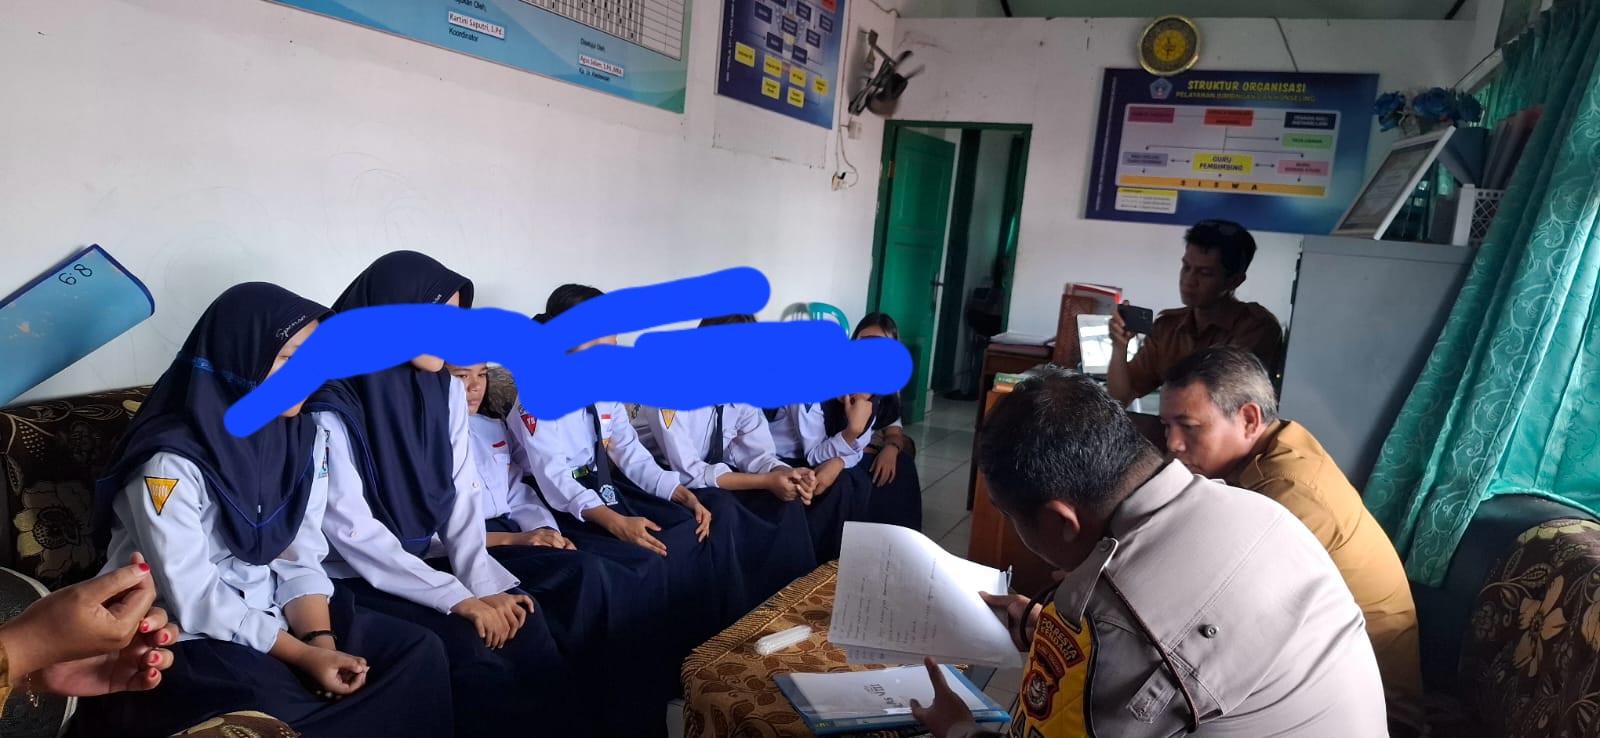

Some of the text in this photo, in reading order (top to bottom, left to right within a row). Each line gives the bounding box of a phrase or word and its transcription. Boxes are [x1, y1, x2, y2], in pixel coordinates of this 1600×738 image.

[449, 13, 468, 25] Kartini
[1187, 80, 1307, 93] STRUKTUR ORGANISASI
[1199, 162, 1244, 171] PEMBIMBING
[1040, 625, 1072, 661] KENDARI
[1041, 617, 1078, 660] POLRESTA
